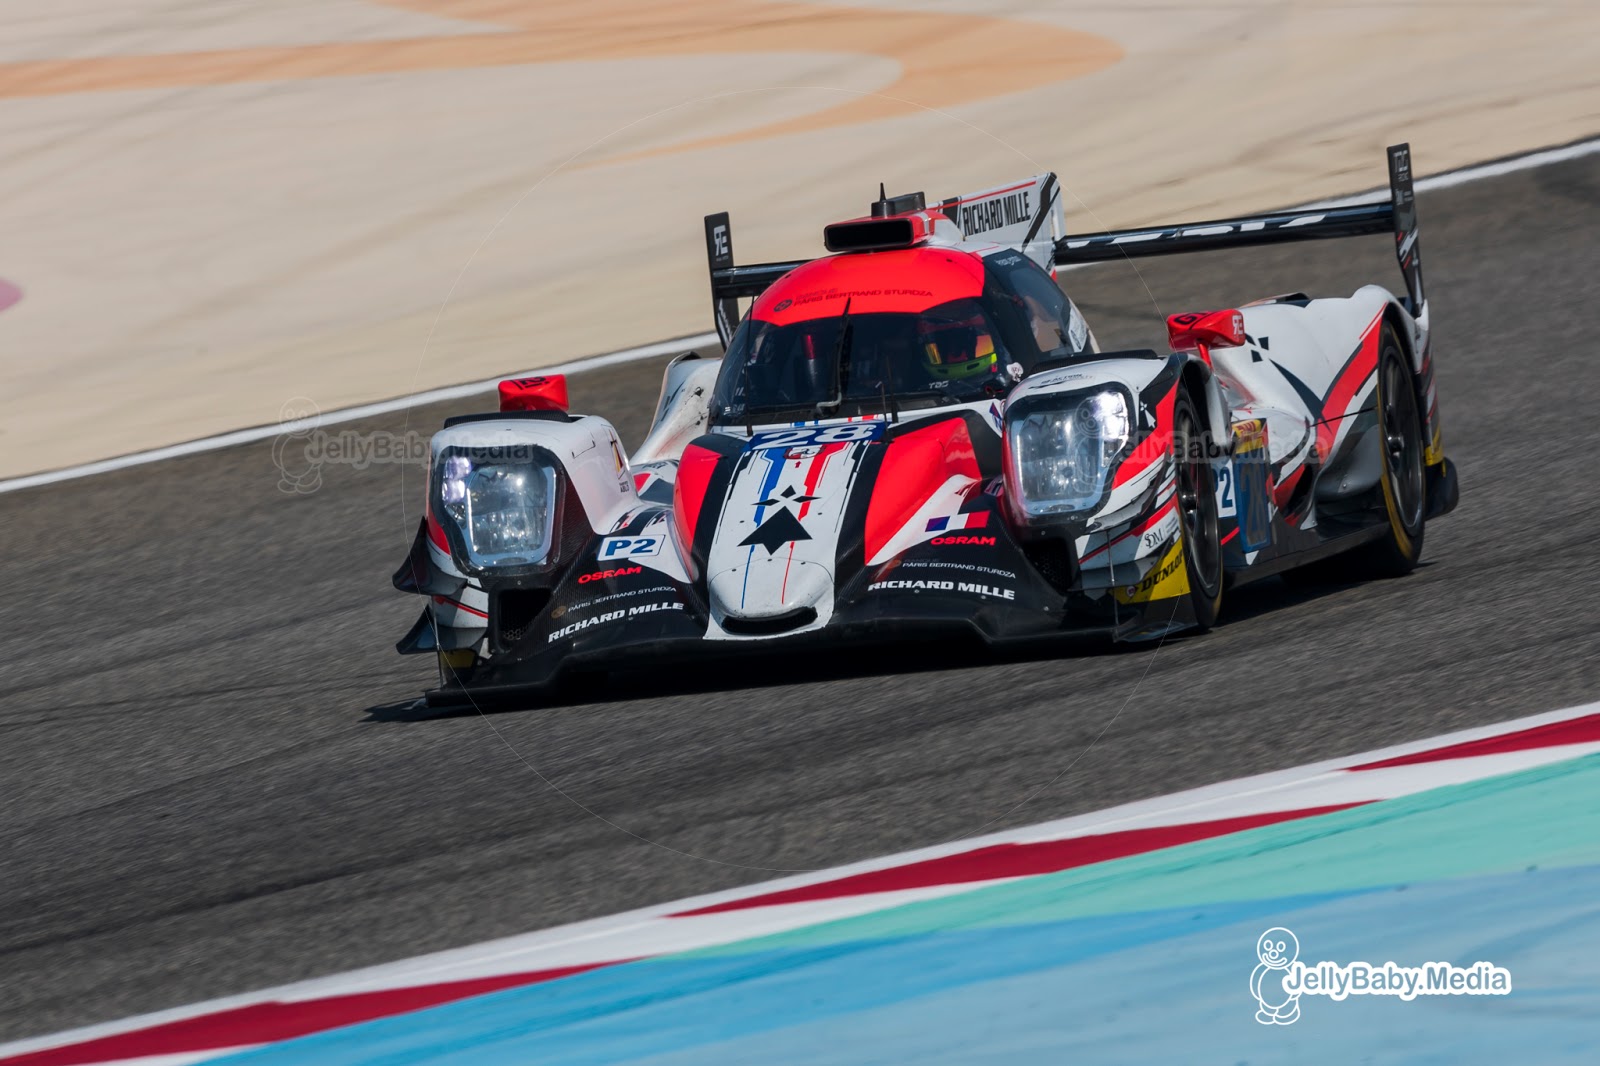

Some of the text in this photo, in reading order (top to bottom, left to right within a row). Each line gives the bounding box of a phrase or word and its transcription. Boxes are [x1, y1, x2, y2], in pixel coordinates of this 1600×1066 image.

[962, 191, 1031, 237] RICHARD MILLE
[825, 289, 881, 301] BERTRAND
[884, 289, 933, 297] STURDZA
[752, 424, 877, 450] 28
[605, 538, 656, 556] P2
[930, 536, 997, 546] OSRAM
[577, 566, 643, 584] OSRAM
[929, 562, 976, 571] BERTRAND
[976, 566, 1016, 579] STURDZA
[592, 590, 636, 605] BERTRAND
[637, 586, 677, 595] STURDZA
[867, 580, 1016, 600] RICHARD MILLE
[547, 602, 685, 643] RICHARD MILLE
